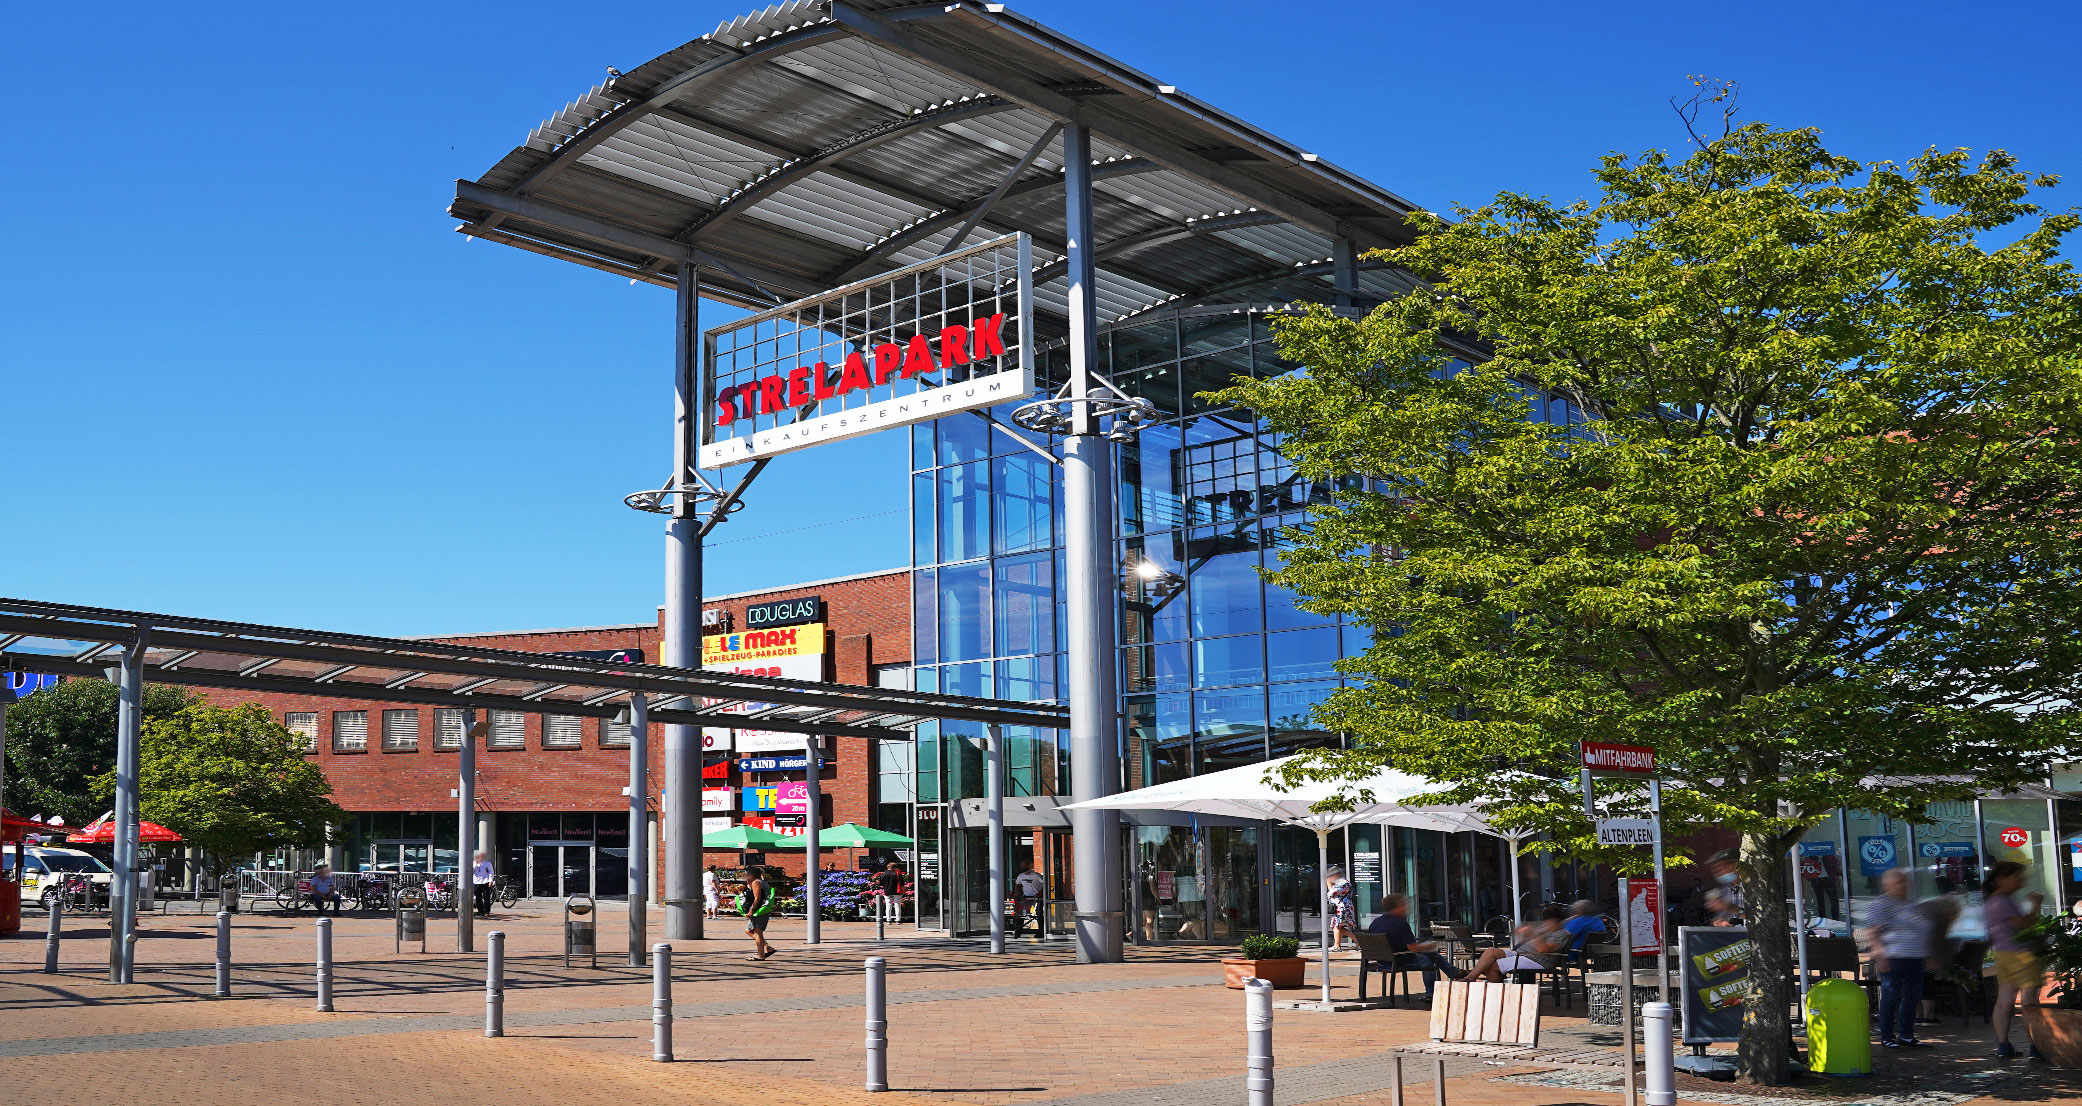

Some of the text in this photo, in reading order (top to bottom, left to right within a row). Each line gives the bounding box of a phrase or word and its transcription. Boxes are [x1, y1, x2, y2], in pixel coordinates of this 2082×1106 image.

[718, 312, 1007, 427] STRELAPARK
[715, 382, 1001, 458] EINKAUFSZENTRUM
[748, 600, 814, 624] DOUGLAS
[744, 628, 797, 650] MAX
[750, 759, 776, 769] KIND
[1594, 748, 1654, 769] MITFAHRBANK
[702, 796, 723, 808] amily
[755, 788, 777, 809] TE
[918, 810, 939, 820] BLU
[1601, 828, 1653, 843] ALTENPLEEN
[2001, 833, 2027, 842] 70%
[1713, 941, 1751, 962] SOFTEIS
[1718, 979, 1749, 996] SOFTE
